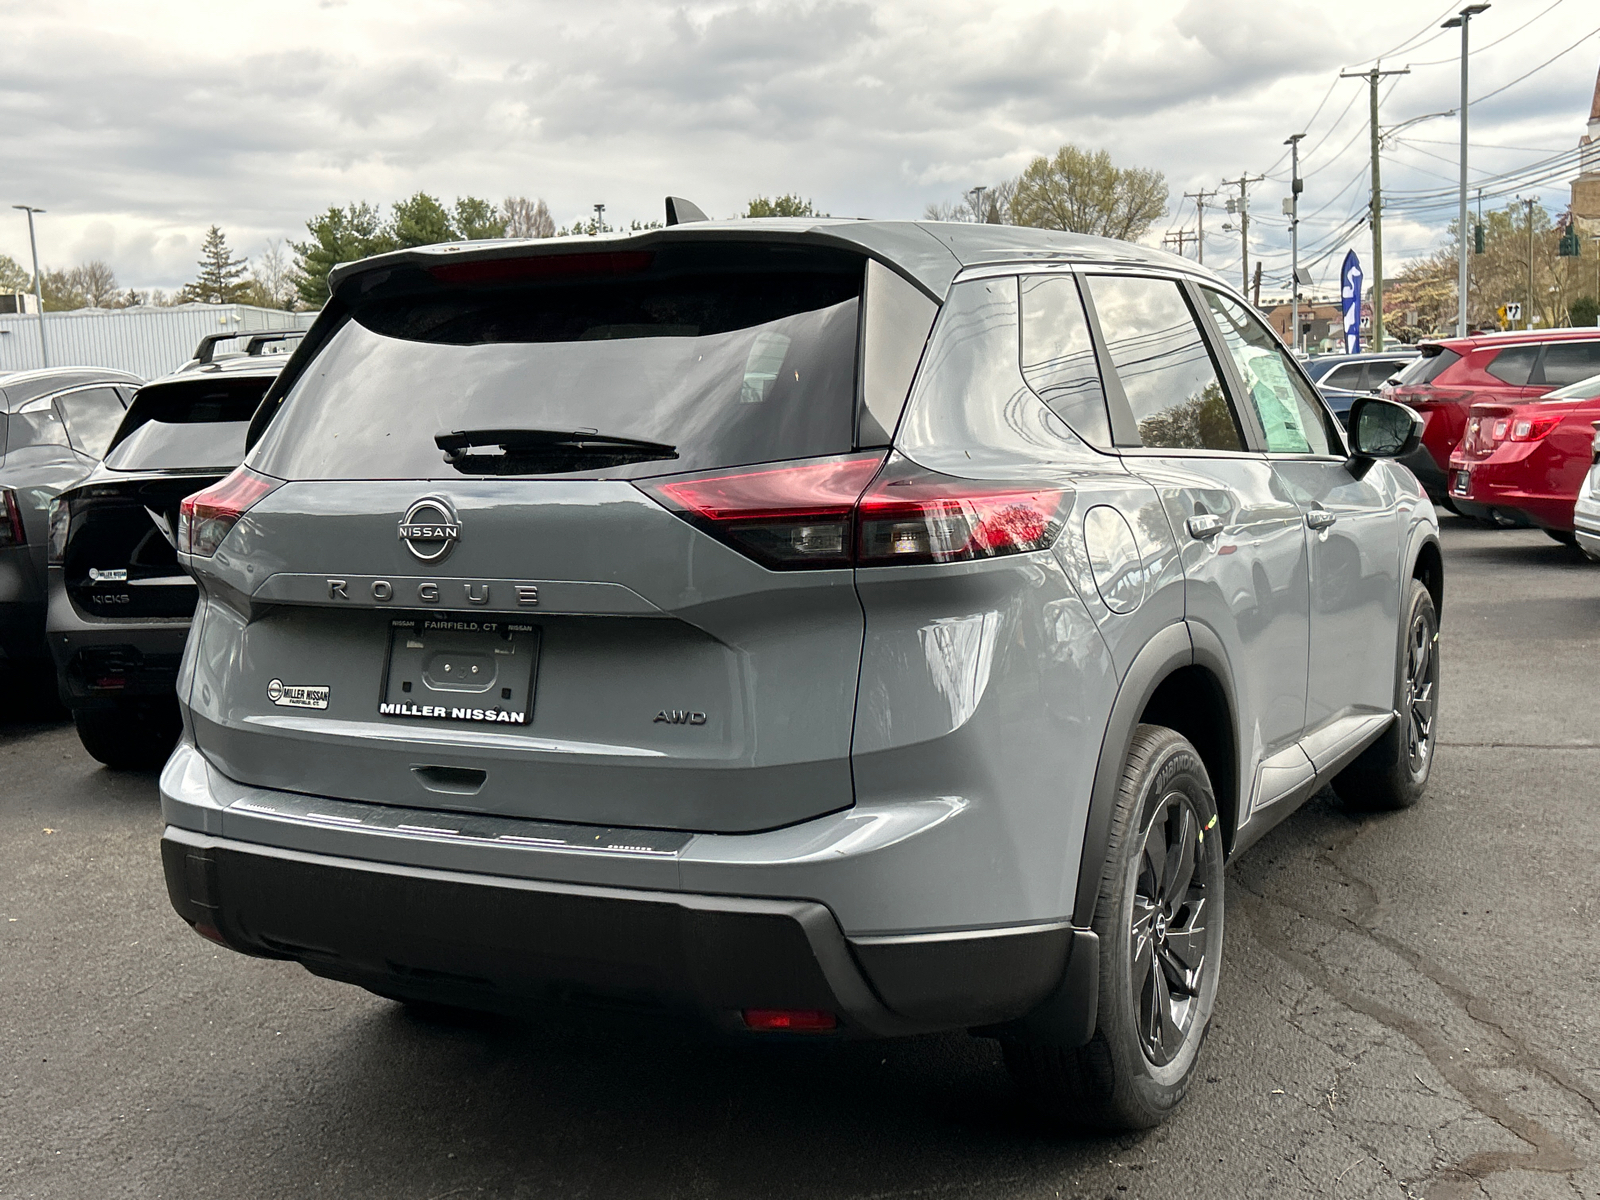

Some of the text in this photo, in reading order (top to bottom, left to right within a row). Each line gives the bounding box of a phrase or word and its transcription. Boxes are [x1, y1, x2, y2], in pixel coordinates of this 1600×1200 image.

[399, 526, 458, 538] NISSAN
[92, 594, 130, 604] KICKS
[326, 579, 540, 607] ROGUE
[424, 620, 498, 632] FAIRFIELD, CT
[507, 624, 533, 632] NISSAN
[283, 687, 329, 701] MILLER NISSAN
[380, 703, 525, 723] MILLER NISSAN
[653, 709, 708, 725] AWD
